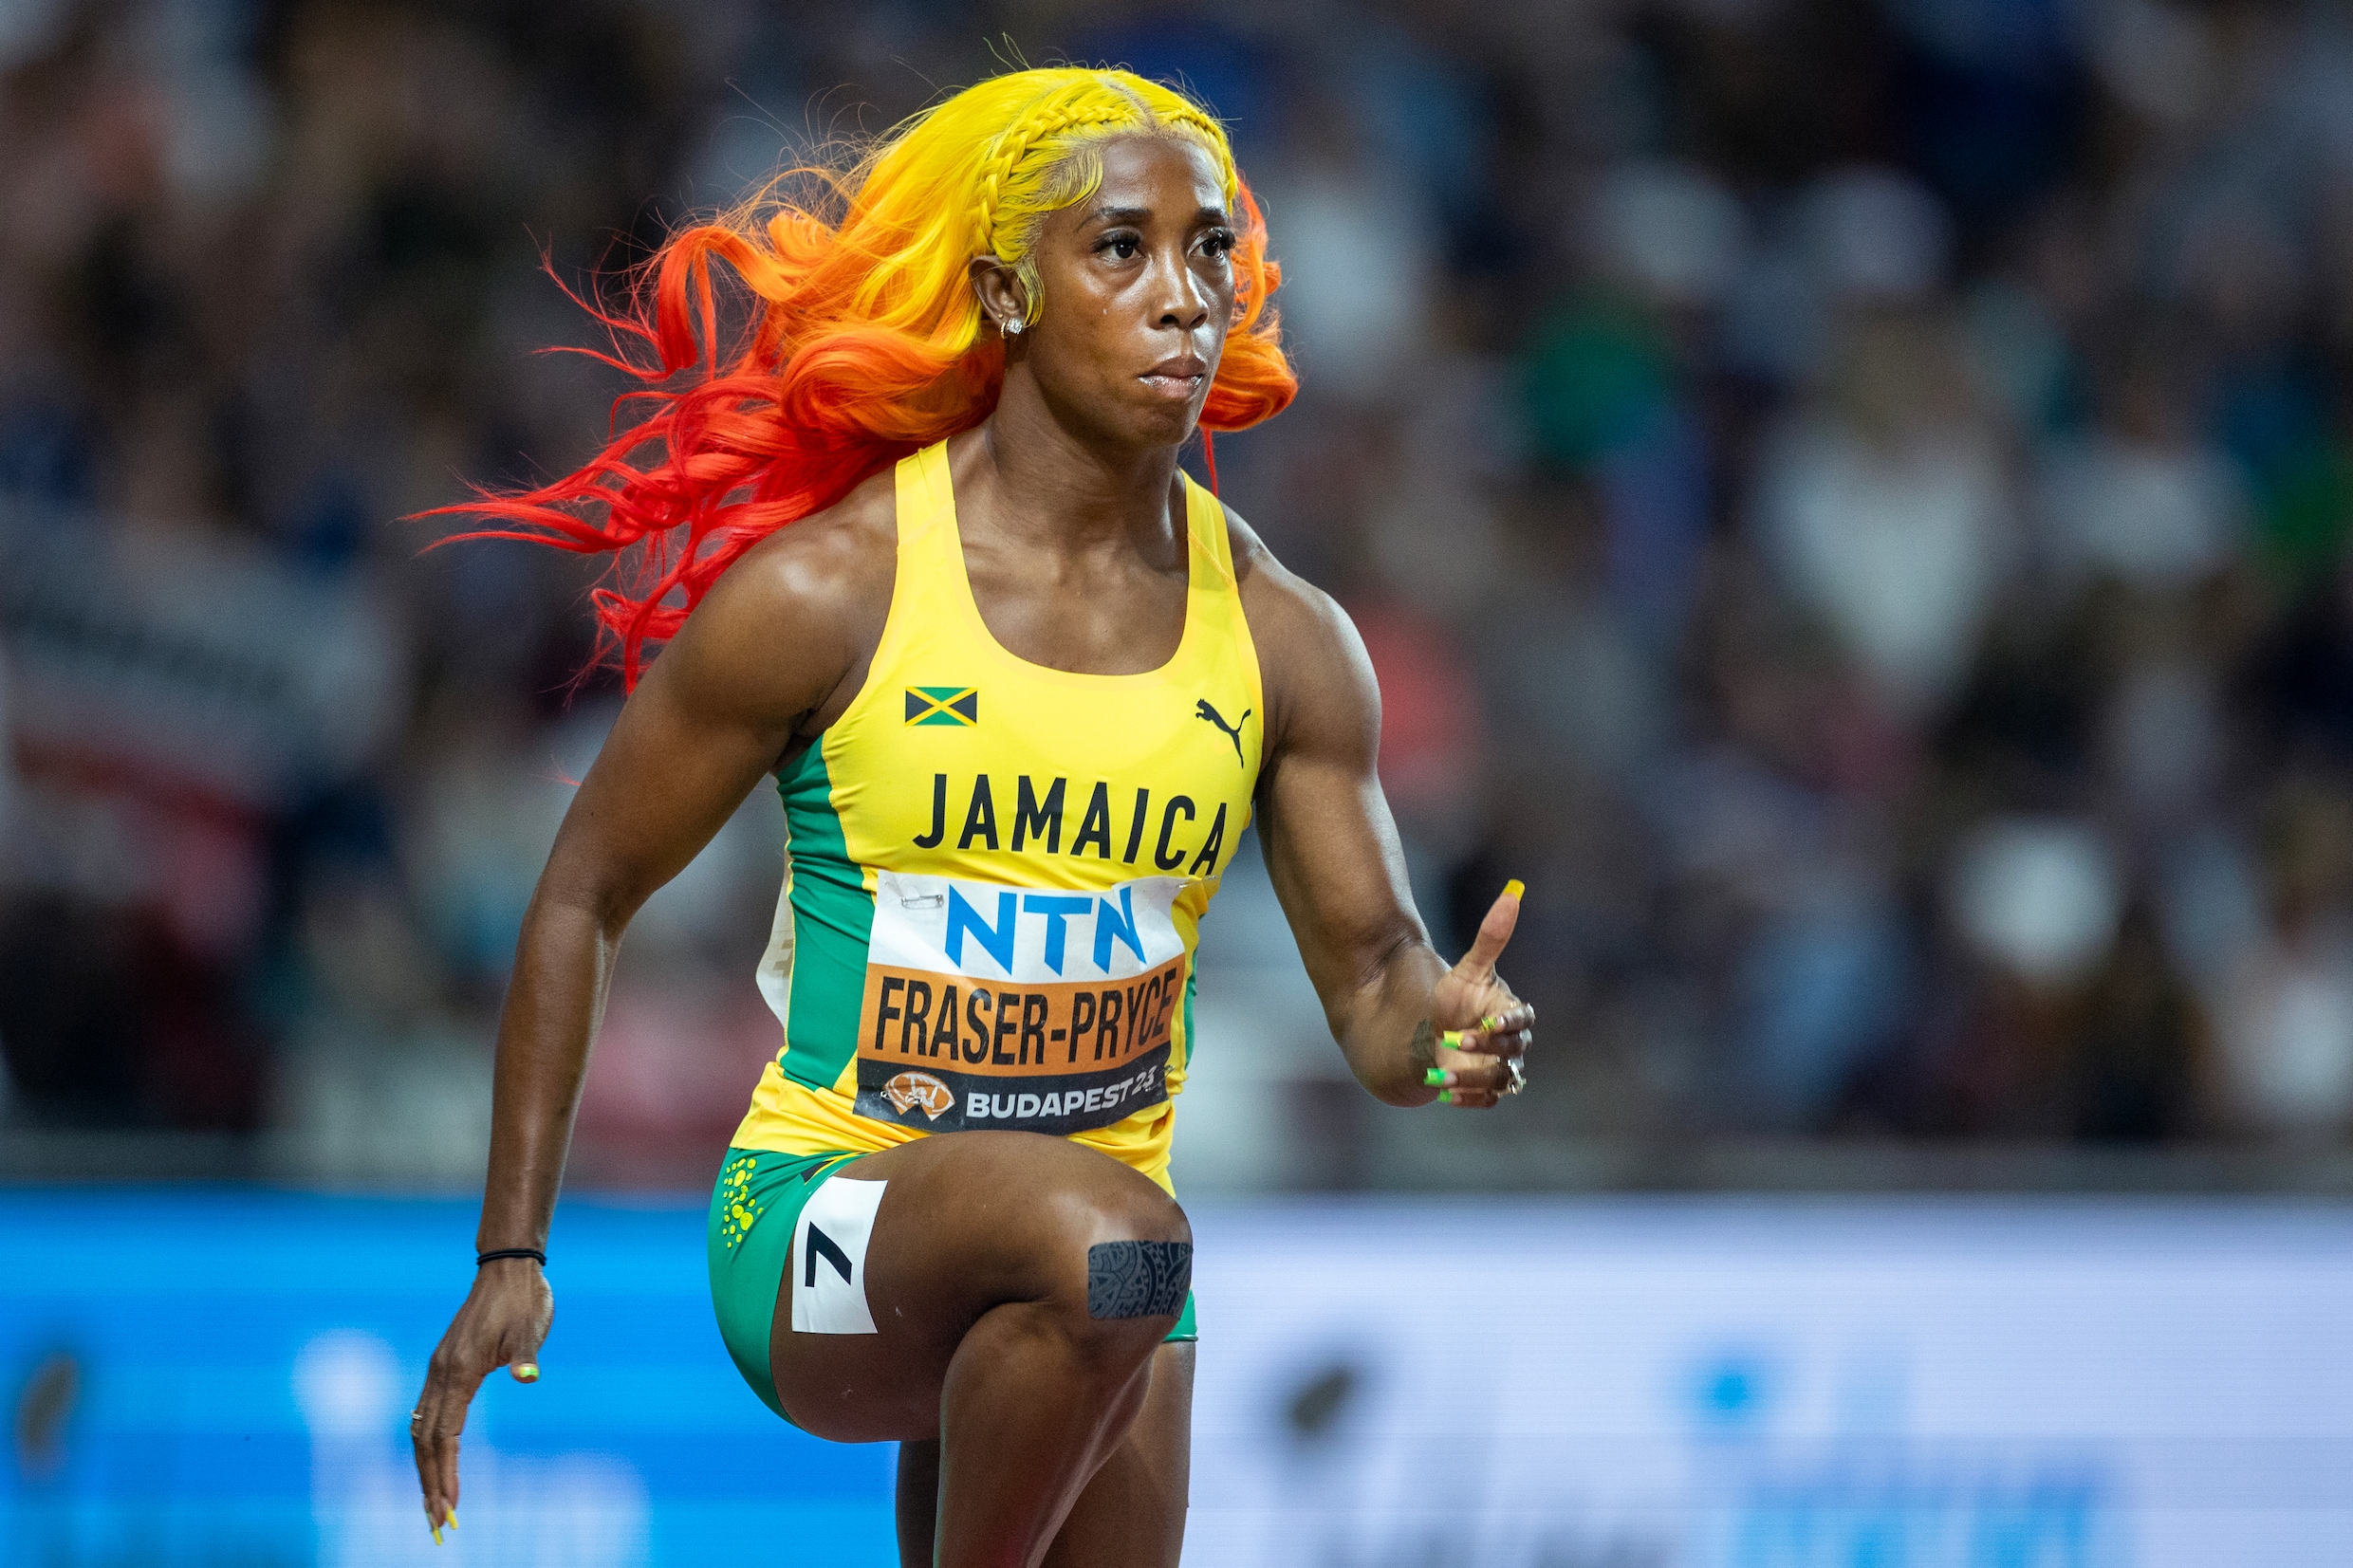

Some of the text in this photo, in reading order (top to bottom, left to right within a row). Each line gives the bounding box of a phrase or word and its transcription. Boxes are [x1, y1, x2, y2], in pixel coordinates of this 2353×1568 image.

[913, 773, 1227, 876] JAMAICA
[944, 885, 1147, 977] NTN
[875, 967, 1177, 1066] FRASER-PRYCE
[966, 1064, 1158, 1119] BUDAPEST 23
[805, 1221, 853, 1288] 7
